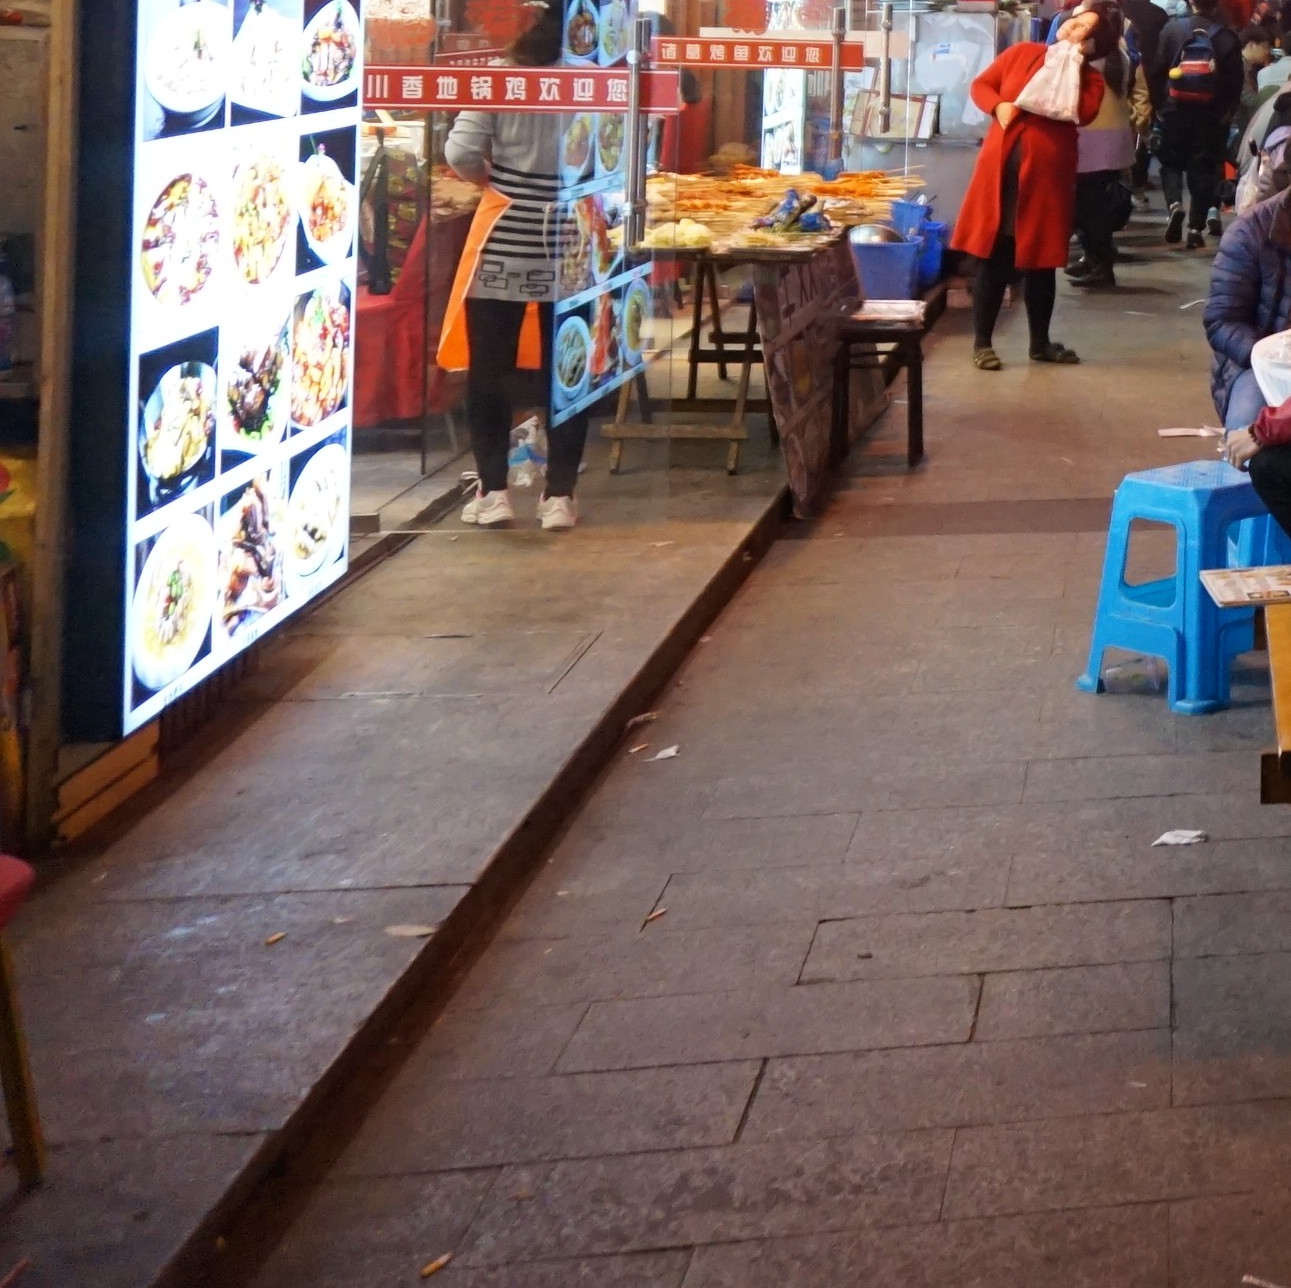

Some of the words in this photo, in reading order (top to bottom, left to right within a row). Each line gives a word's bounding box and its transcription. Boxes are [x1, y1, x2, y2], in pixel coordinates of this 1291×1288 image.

[660, 42, 823, 64] 诸葛烤鱼欢迎您
[367, 74, 630, 103] 川香地锅鸡欢迎您
